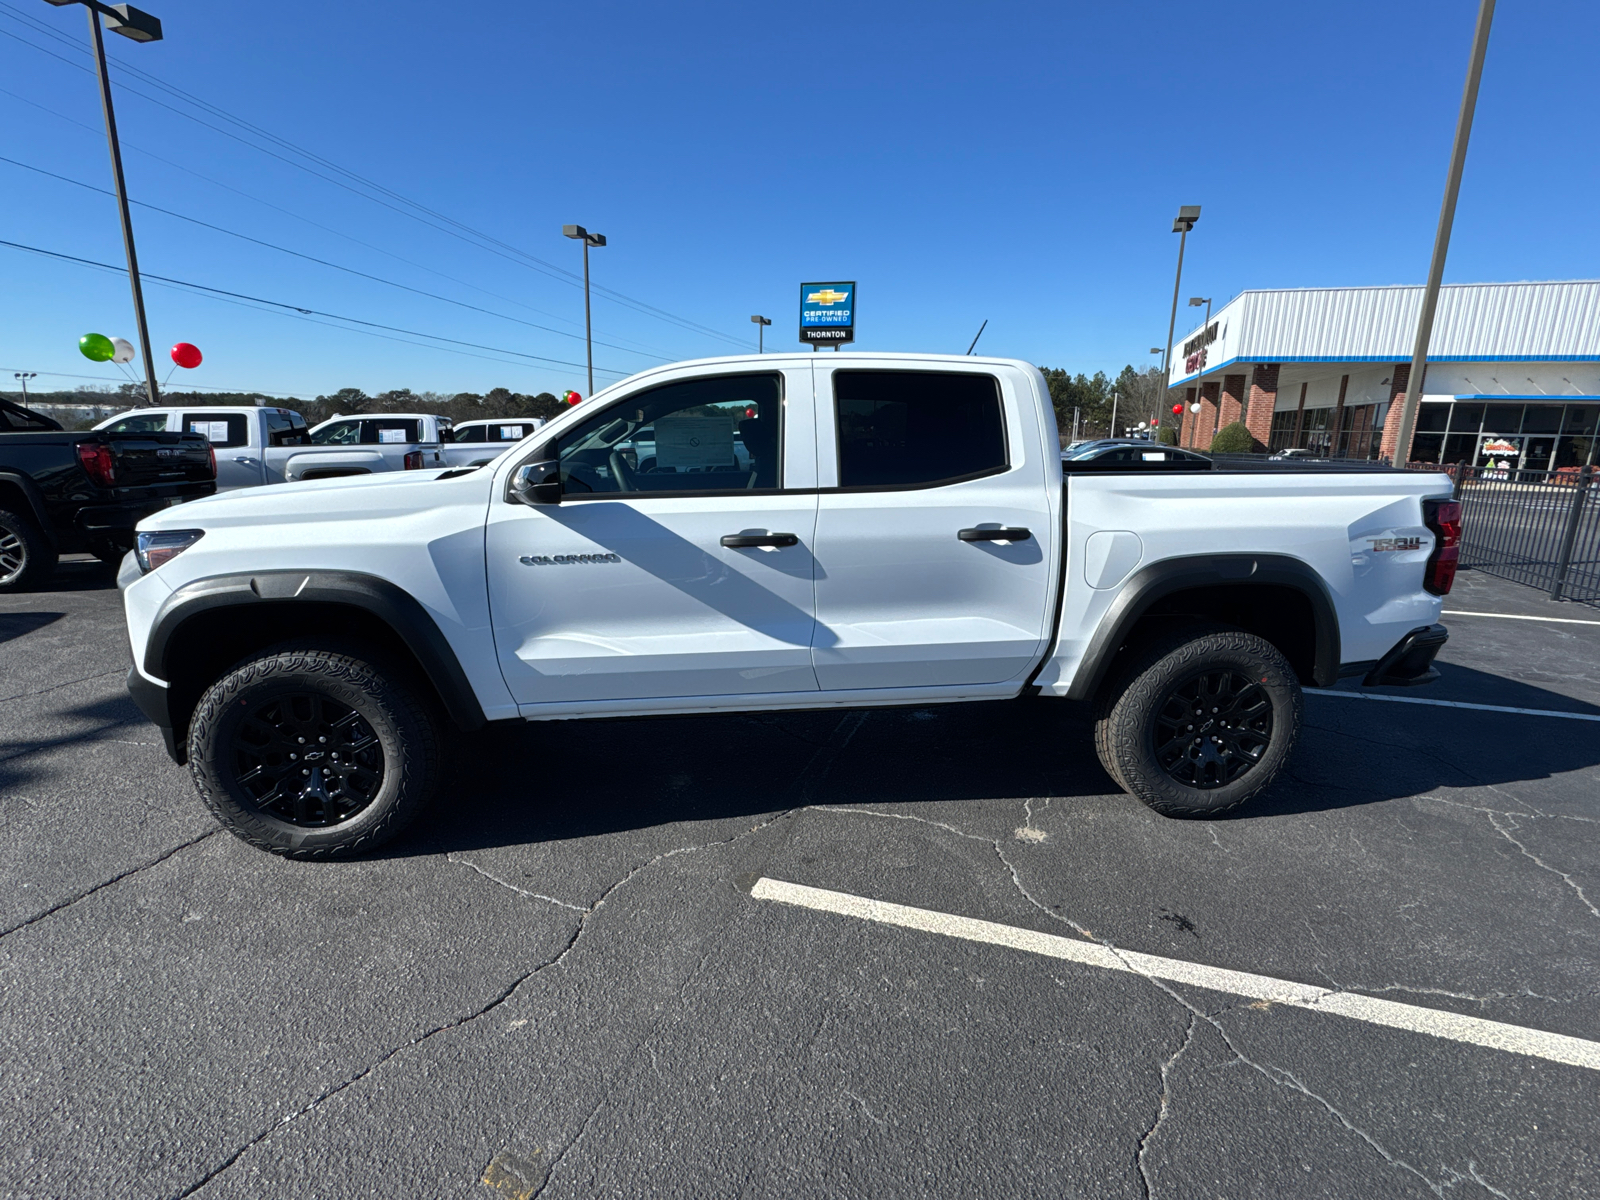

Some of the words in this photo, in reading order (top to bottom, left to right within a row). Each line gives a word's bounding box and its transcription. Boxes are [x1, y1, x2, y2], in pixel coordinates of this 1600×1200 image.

[1366, 537, 1428, 546] TRAIL
[1373, 544, 1420, 552] BOSS
[518, 553, 618, 564] COLORADO
